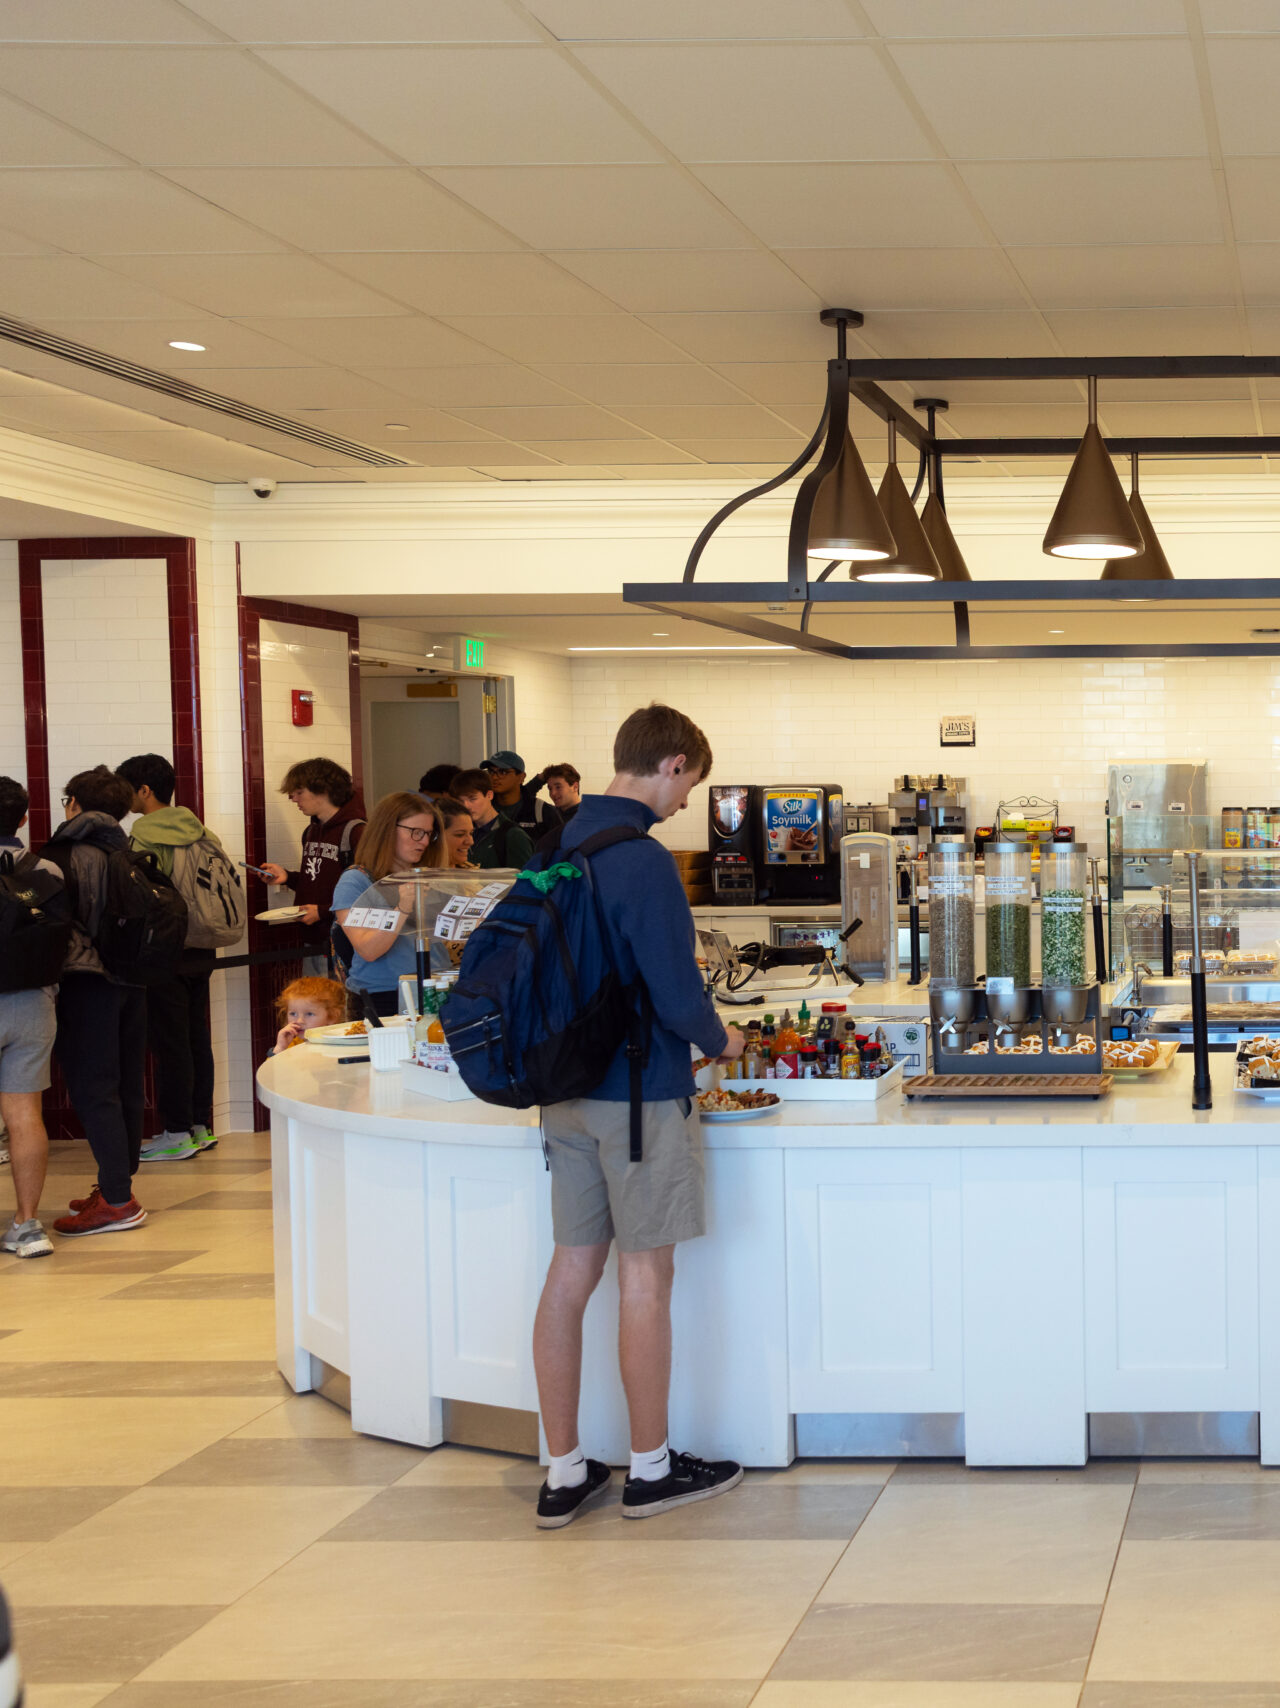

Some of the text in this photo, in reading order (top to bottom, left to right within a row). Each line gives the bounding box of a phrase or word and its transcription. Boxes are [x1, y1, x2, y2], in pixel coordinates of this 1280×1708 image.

[466, 640, 484, 668] EXIT
[946, 722, 970, 731] JIM'S
[782, 800, 803, 814] Silk
[772, 814, 813, 827] Soymilk
